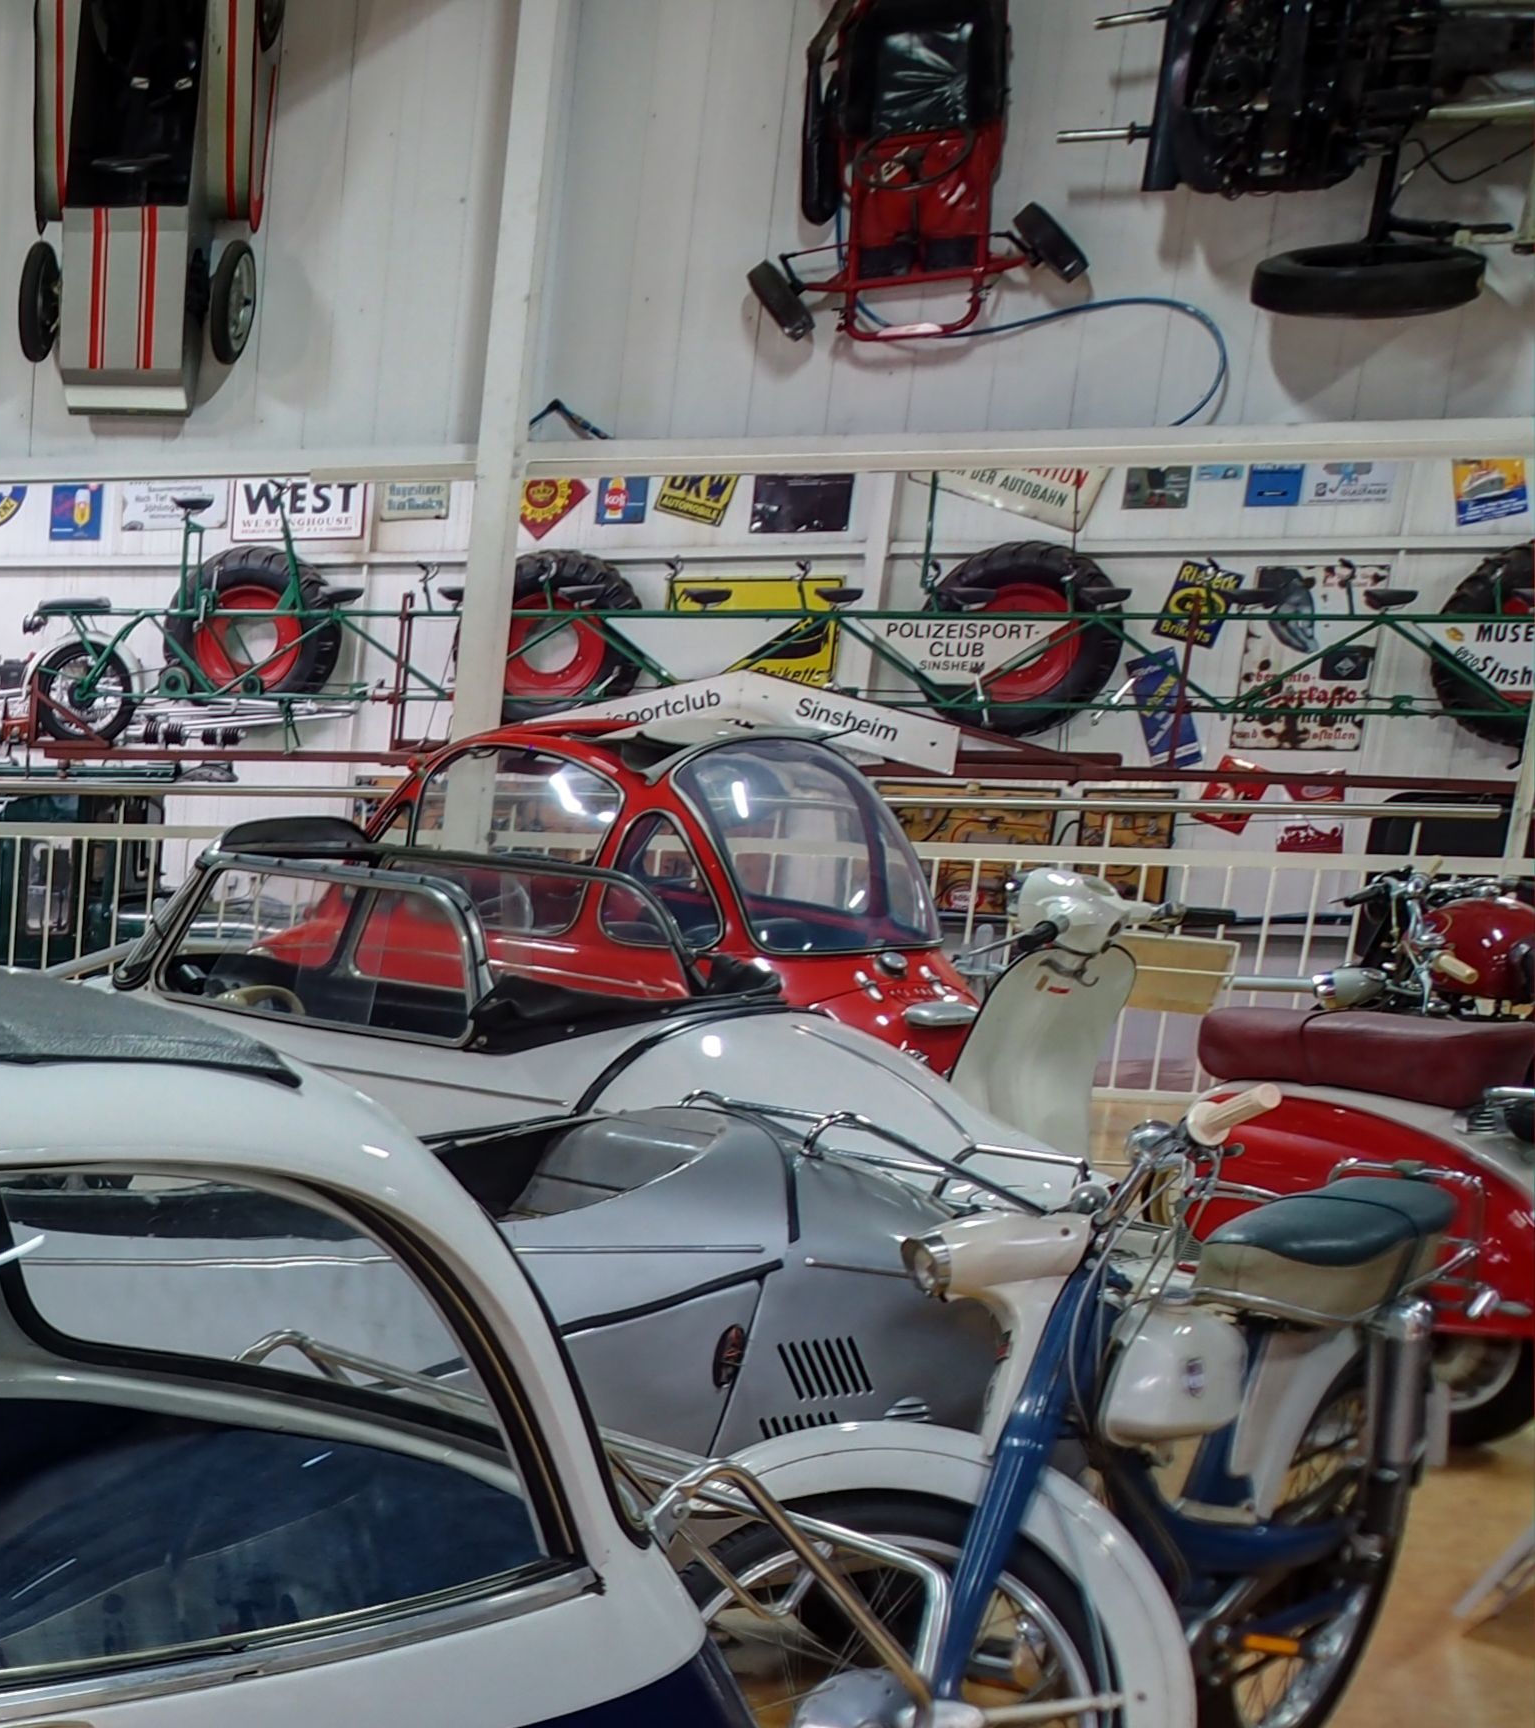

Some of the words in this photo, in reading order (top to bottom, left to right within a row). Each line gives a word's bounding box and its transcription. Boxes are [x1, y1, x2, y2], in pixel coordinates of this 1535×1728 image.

[243, 483, 358, 515] WEST
[999, 475, 1069, 508] AUTOBAHN
[241, 516, 353, 528] WESTNGHOUSE
[885, 622, 1040, 639] POLIZEISPORT-
[929, 641, 985, 657] CLUB
[795, 697, 898, 742] Sinsheim
